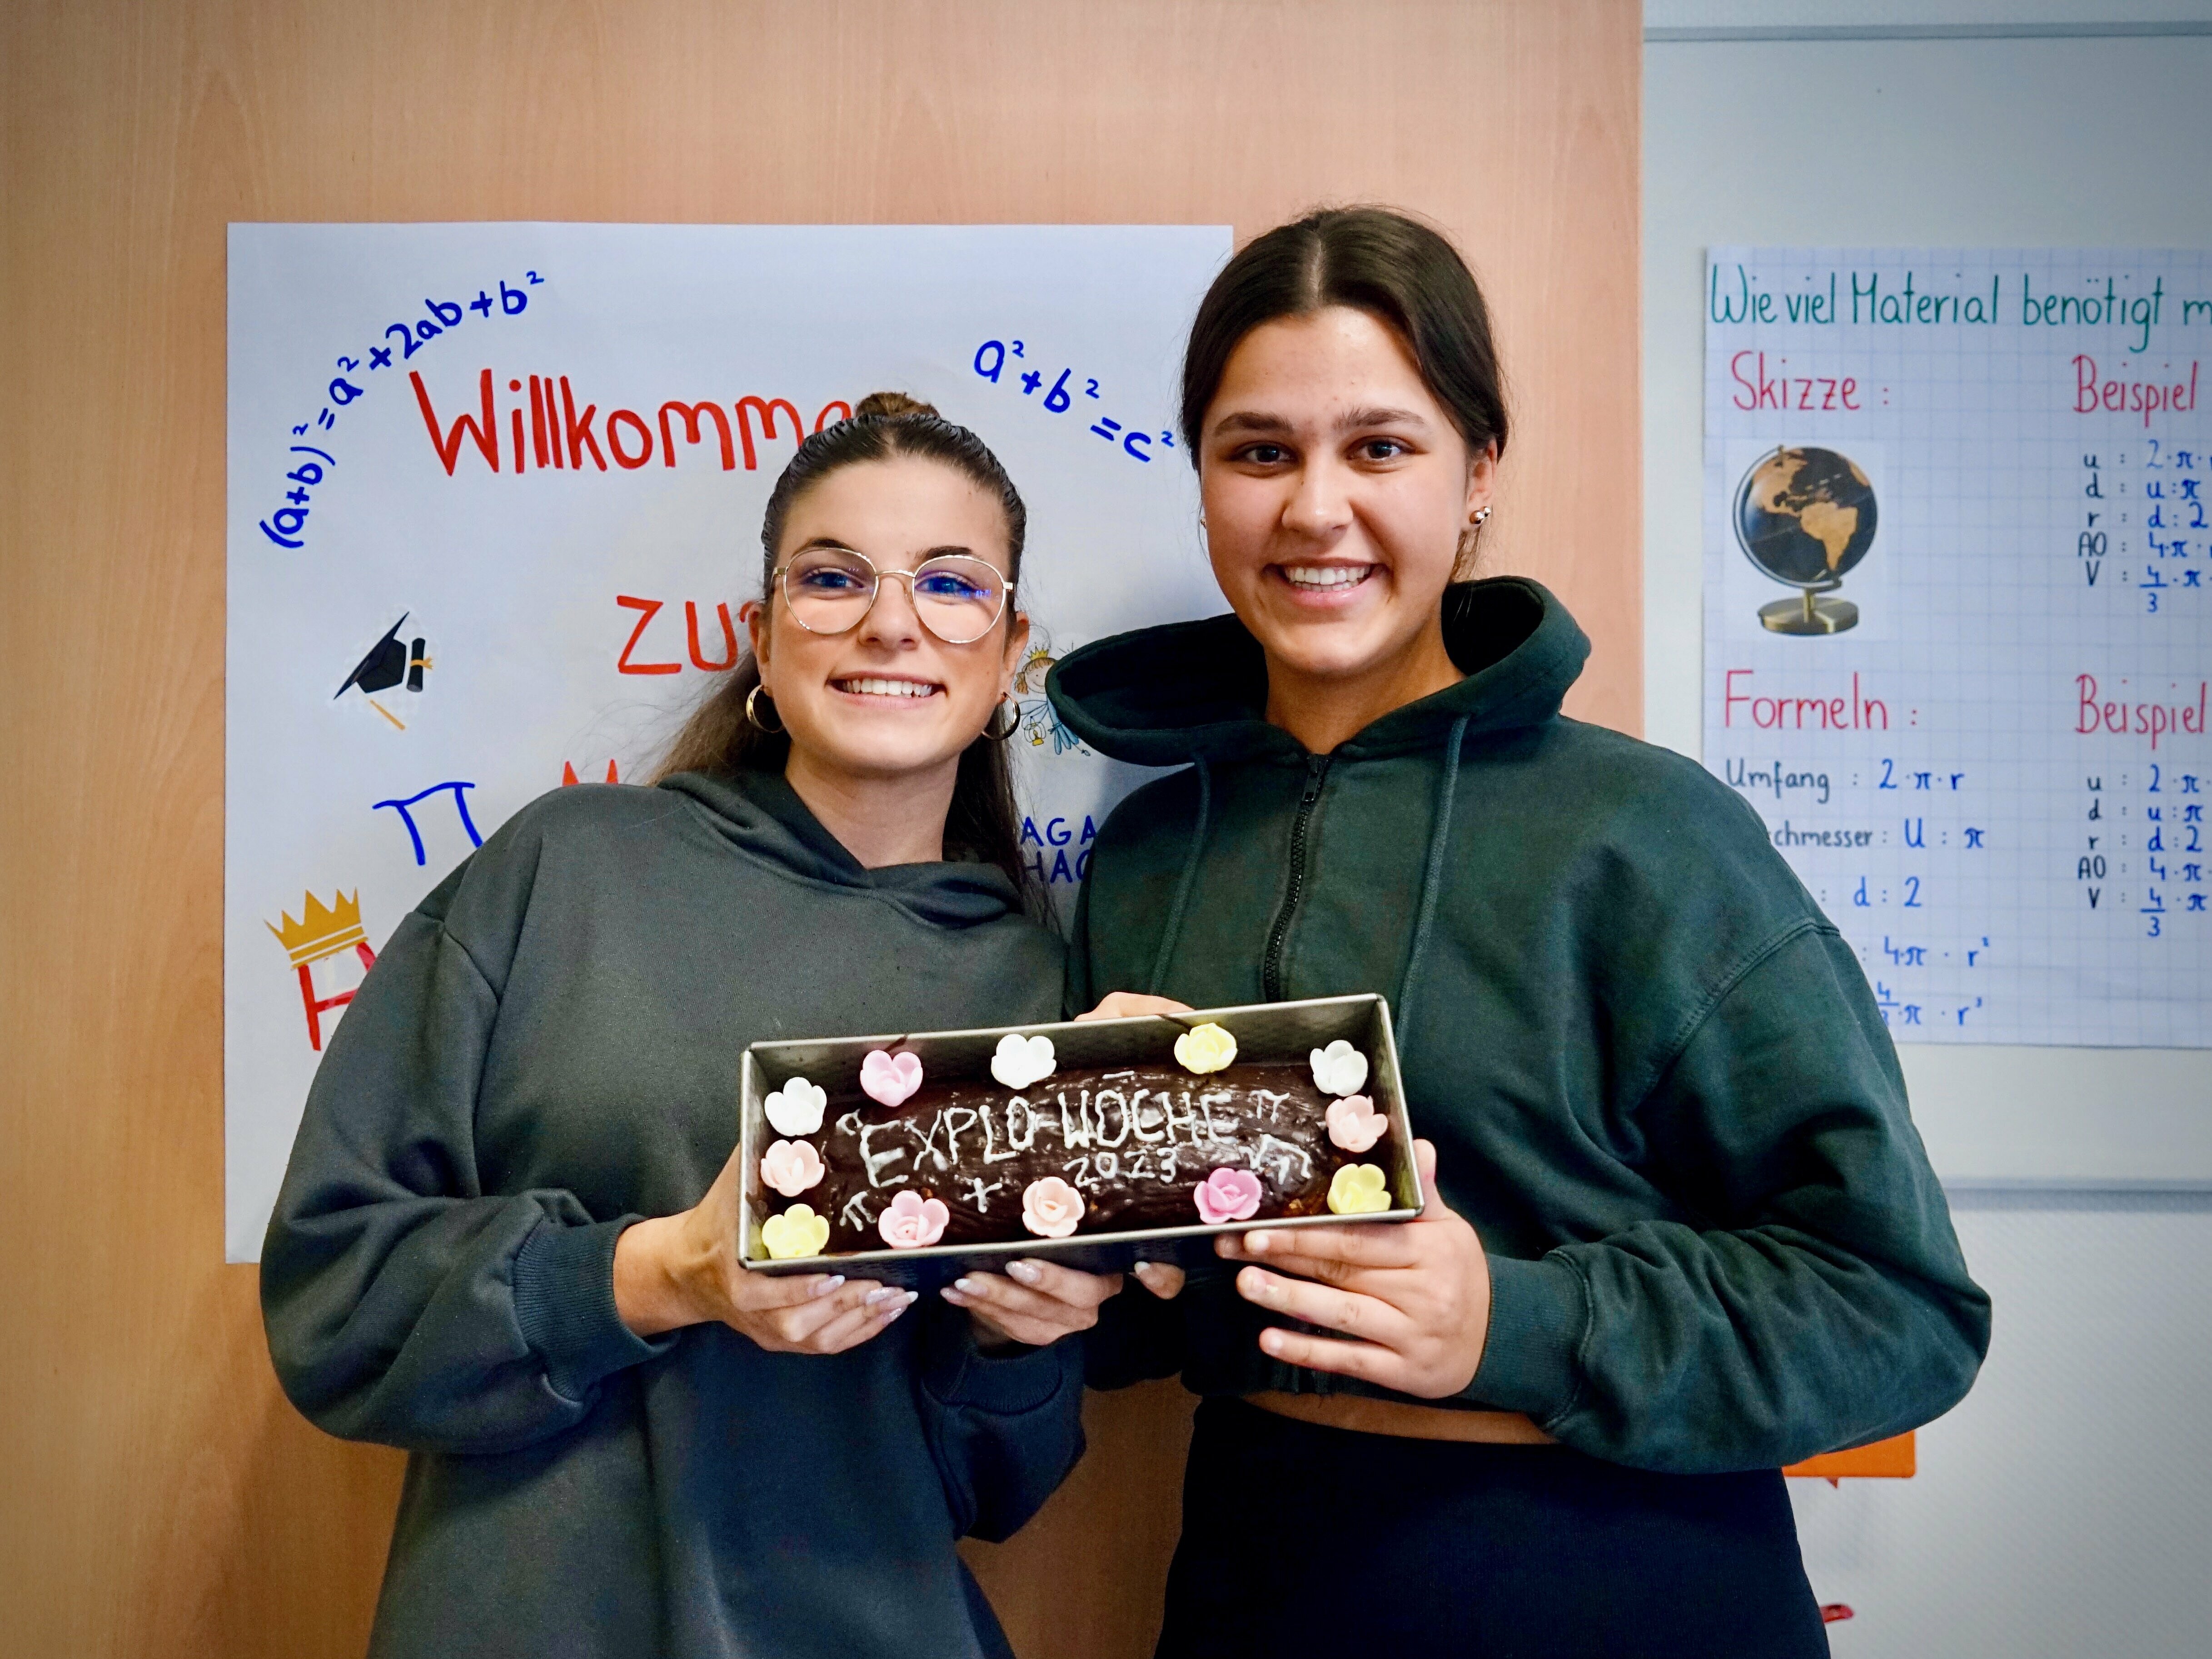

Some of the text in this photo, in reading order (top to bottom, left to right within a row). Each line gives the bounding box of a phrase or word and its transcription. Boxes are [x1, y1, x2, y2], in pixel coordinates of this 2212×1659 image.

[1711, 264, 1778, 324] Wie
[1785, 271, 1835, 324] viel
[1852, 271, 1998, 324] Material
[2023, 273, 2164, 354] benötigt
[1731, 350, 1861, 411] Skizze
[2071, 354, 2198, 428] Beispiel
[409, 369, 853, 476] Willkomm
[2086, 472, 2106, 499] d
[1725, 669, 1888, 730] Formeln
[2074, 673, 2206, 751] Beispiel
[1726, 758, 1829, 804] Umfang
[2089, 798, 2102, 820] d
[1767, 819, 1873, 848] chmesser
[1063, 1147, 1178, 1187] 2023
